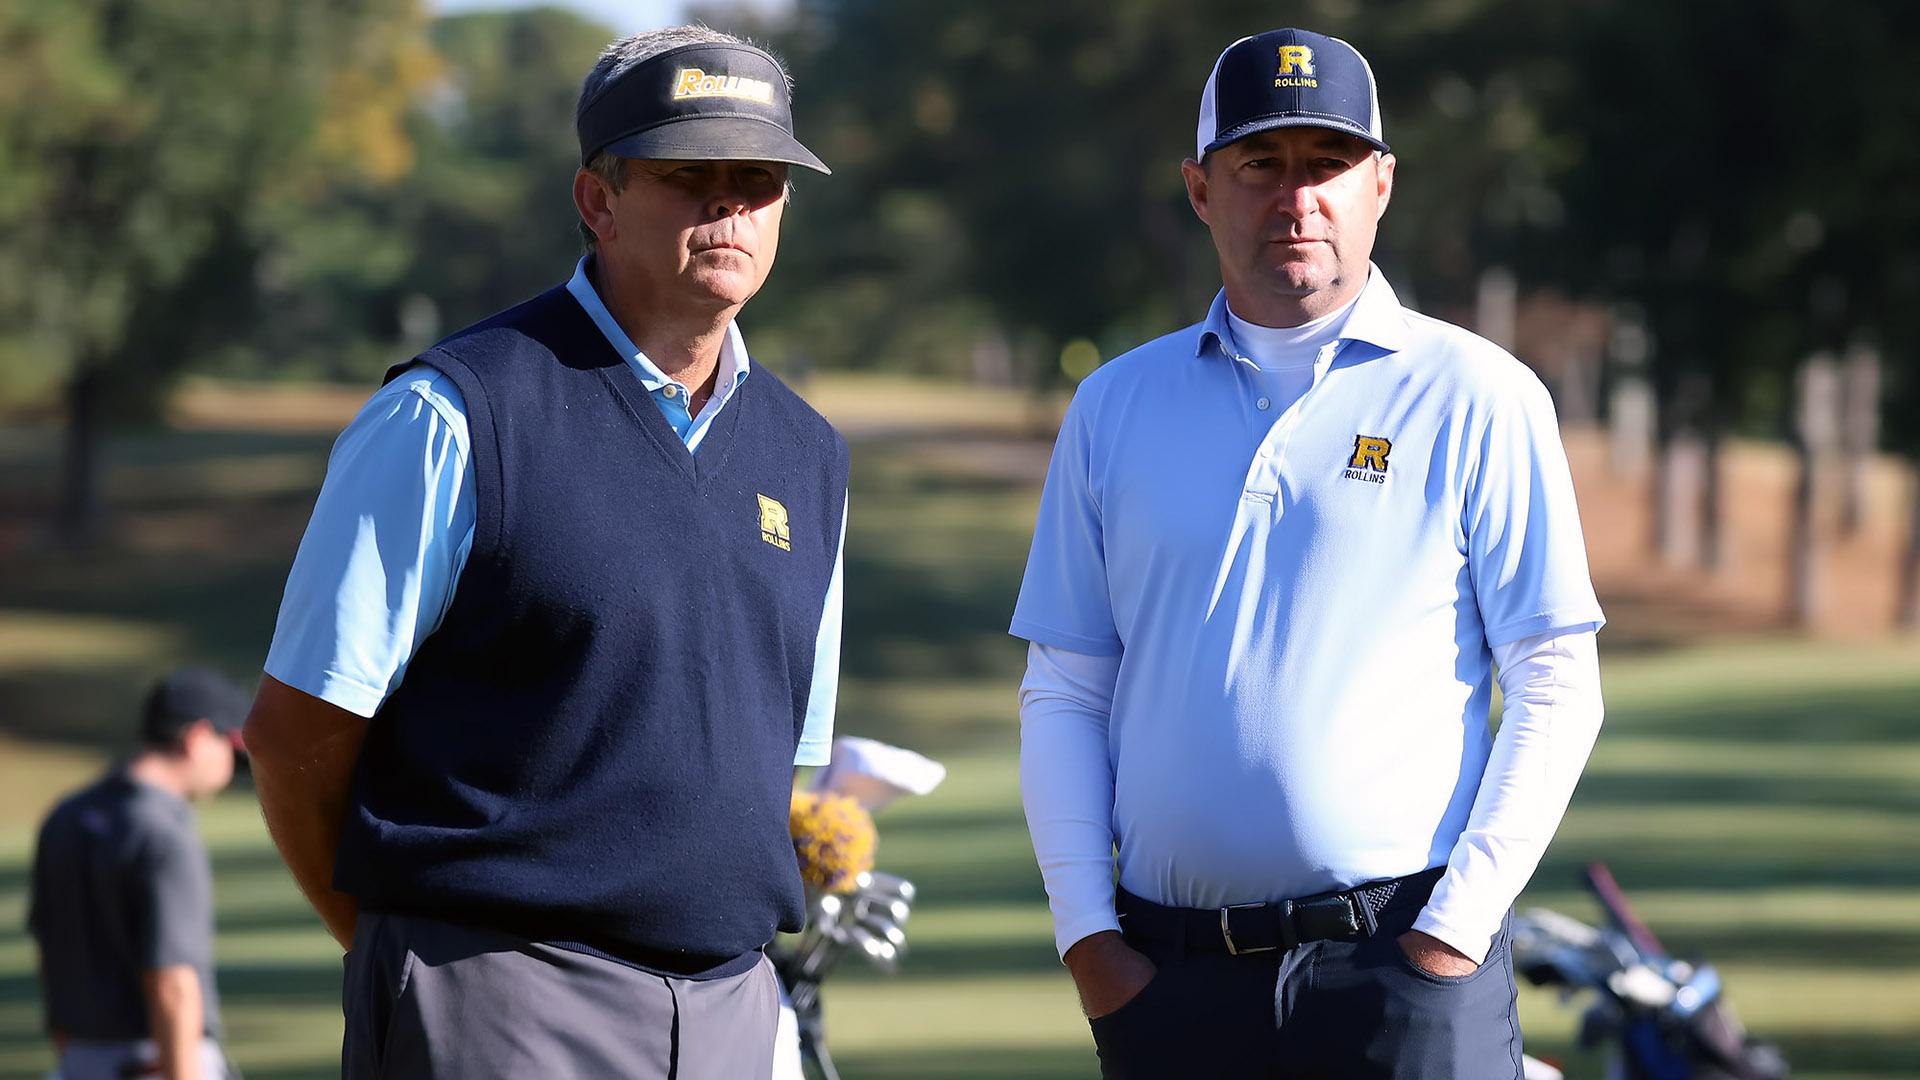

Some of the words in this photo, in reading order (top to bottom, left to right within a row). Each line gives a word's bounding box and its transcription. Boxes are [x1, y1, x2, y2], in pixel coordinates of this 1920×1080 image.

[1277, 45, 1315, 76] R
[1274, 78, 1318, 88] ROLLINS
[1348, 434, 1392, 473] R
[1344, 469, 1386, 484] ROLLINS
[756, 493, 790, 540] R
